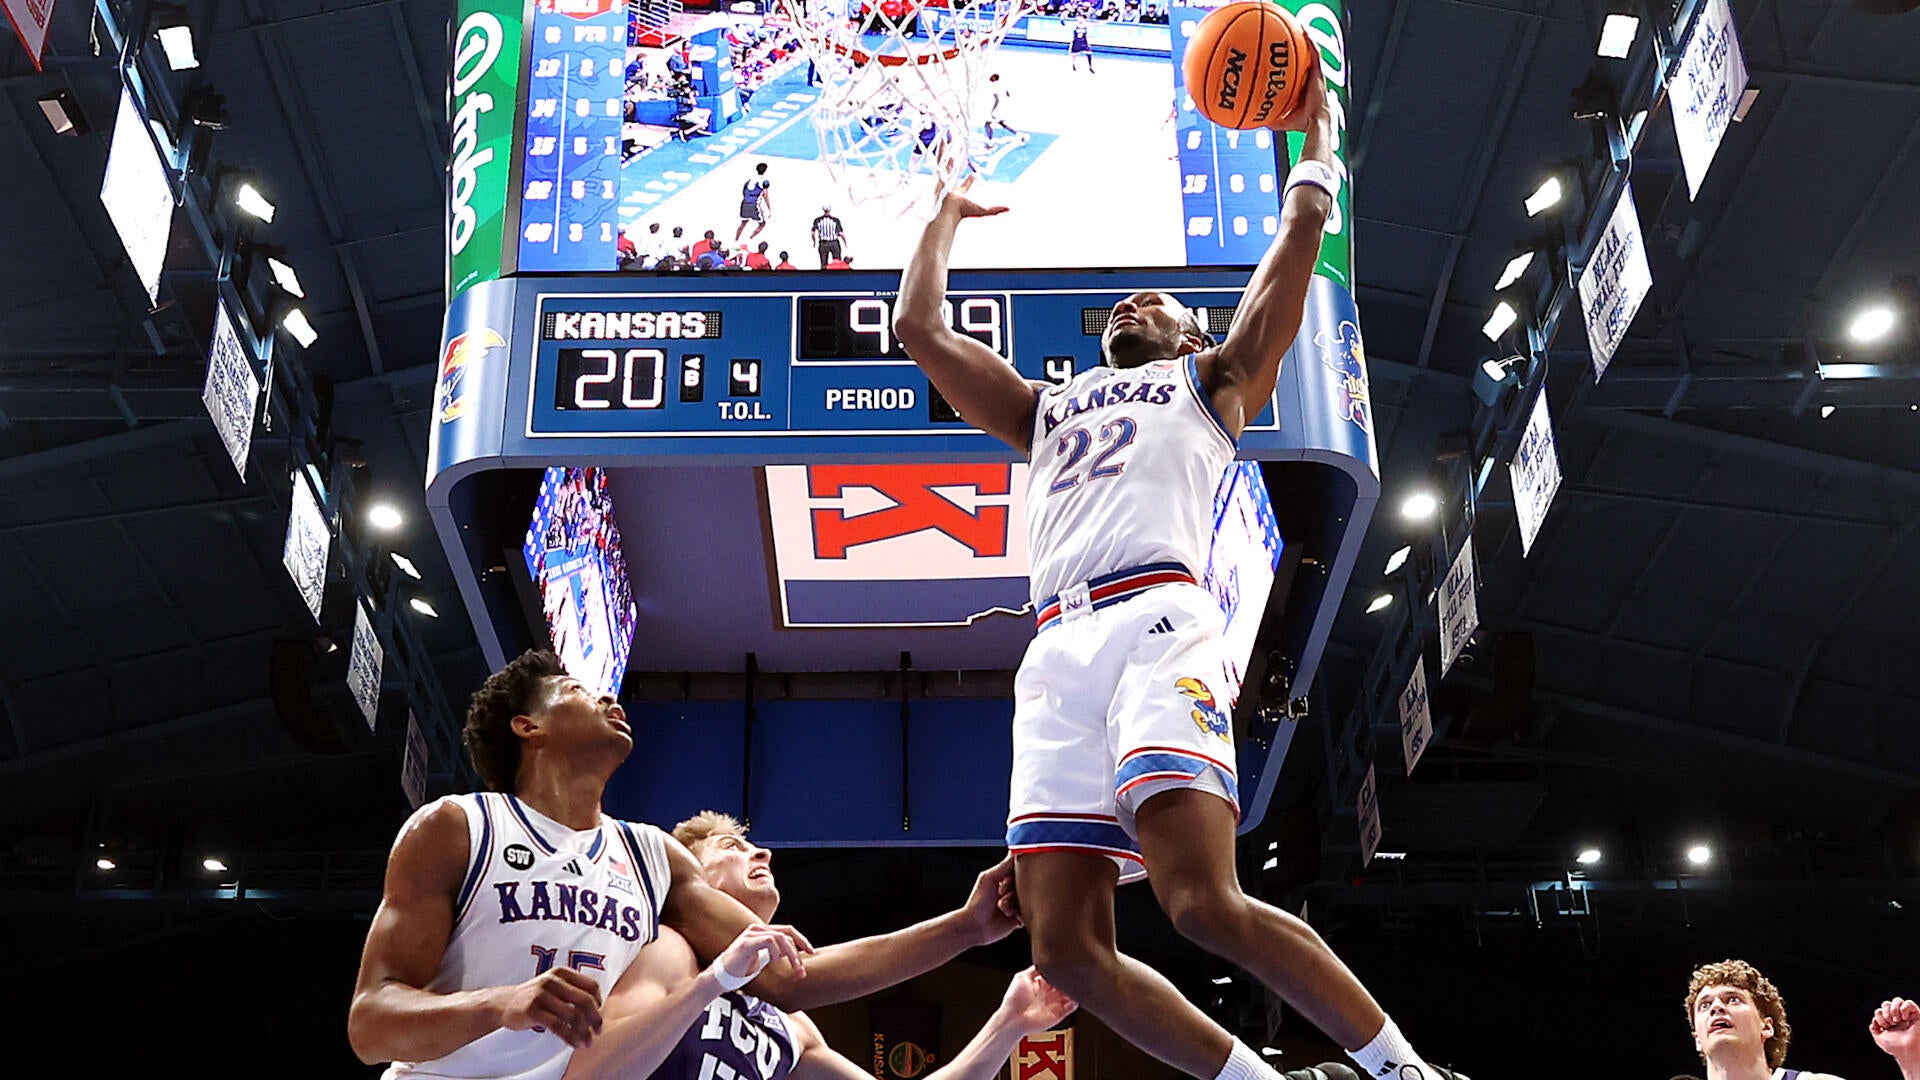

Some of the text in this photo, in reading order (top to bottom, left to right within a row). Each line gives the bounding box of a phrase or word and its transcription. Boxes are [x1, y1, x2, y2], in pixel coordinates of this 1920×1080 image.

[1218, 48, 1247, 111] NCAA
[1252, 41, 1288, 122] Wilson
[1592, 221, 1619, 289] NCAA
[554, 311, 707, 340] KANSAS
[574, 349, 664, 408] 20
[733, 362, 758, 393] 4
[826, 389, 915, 410] PERIOD
[718, 402, 772, 420] T.O.L.
[1044, 382, 1176, 439] KANSAS
[1047, 417, 1137, 497] 22
[507, 848, 531, 865] SW
[493, 881, 640, 942] KANSAS
[701, 997, 781, 1080] TCU
